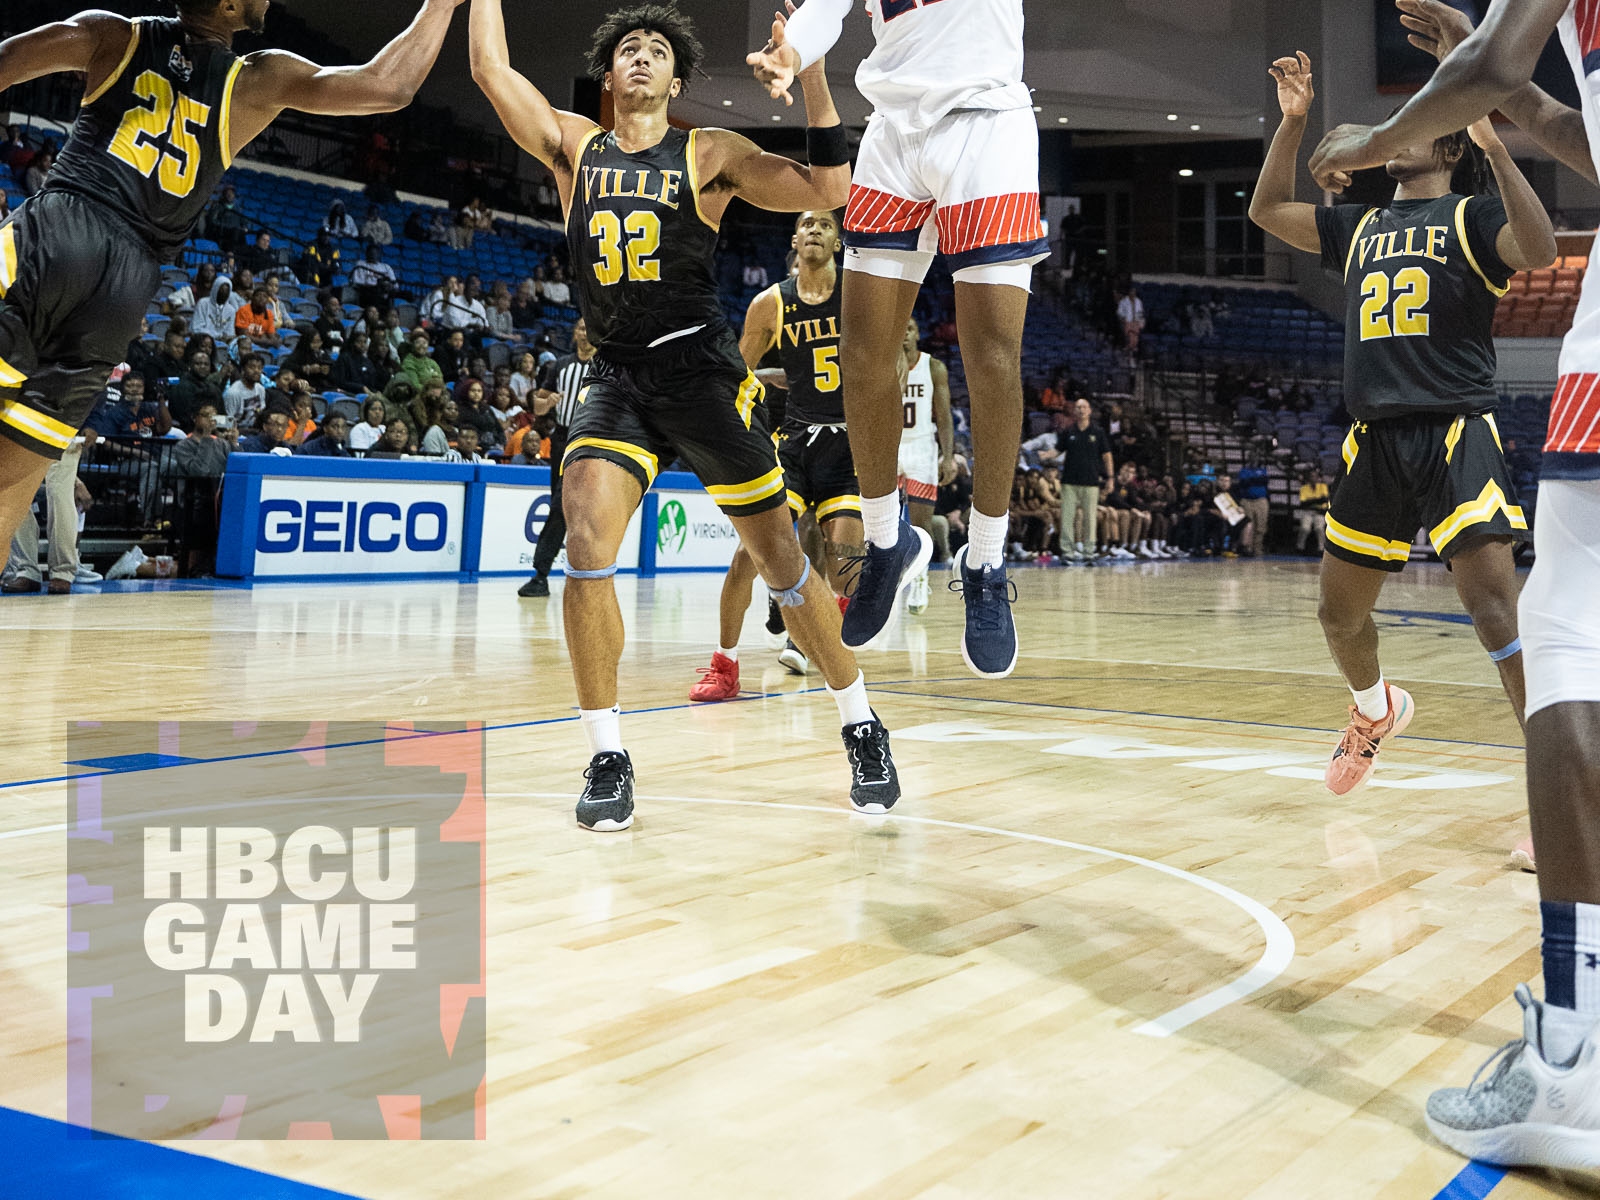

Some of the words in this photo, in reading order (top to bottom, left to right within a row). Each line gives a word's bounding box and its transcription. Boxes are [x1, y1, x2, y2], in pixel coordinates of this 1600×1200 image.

[107, 69, 211, 198] 25
[582, 165, 682, 210] VILLE
[589, 210, 661, 286] 32
[1359, 226, 1449, 269] VILLE
[1360, 267, 1430, 341] 22
[784, 316, 841, 347] VILL
[812, 345, 841, 393] 5
[256, 499, 448, 553] GEICO
[692, 522, 736, 539] VIRGINIA
